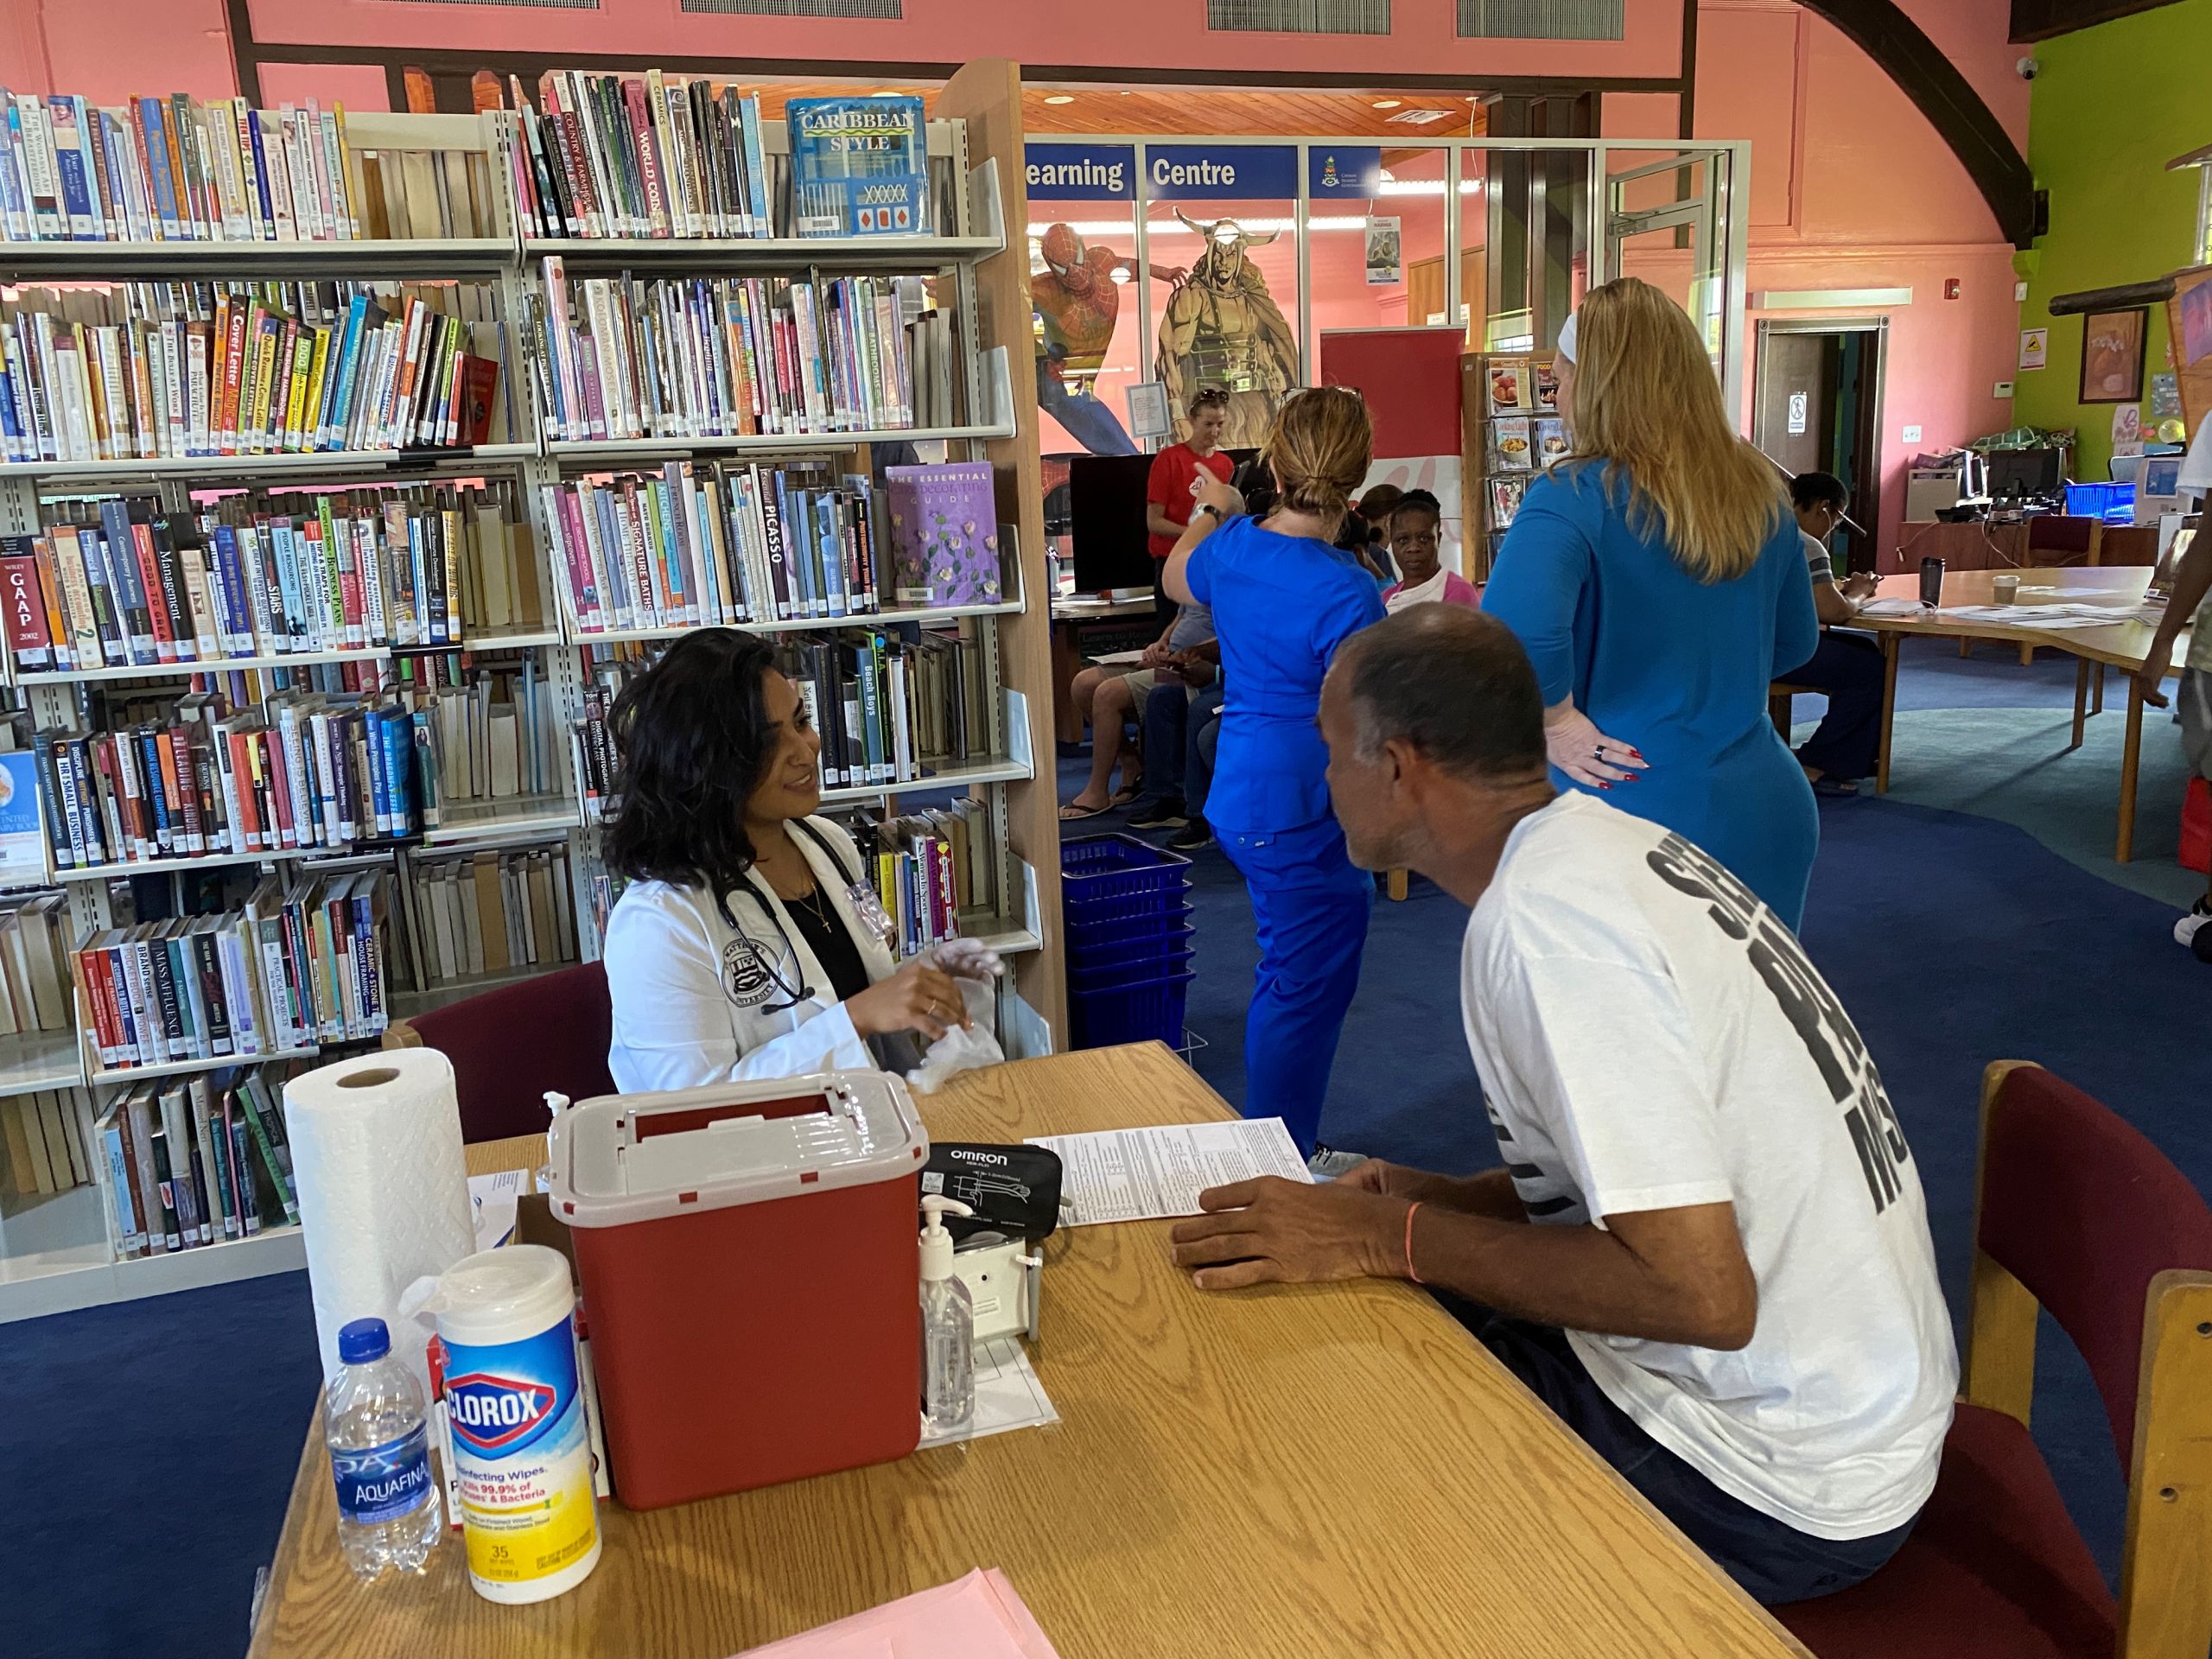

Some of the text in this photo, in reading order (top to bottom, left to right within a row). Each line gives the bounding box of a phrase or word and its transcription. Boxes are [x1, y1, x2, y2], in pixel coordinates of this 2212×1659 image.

[654, 86, 665, 125] CERAMICS
[238, 118, 251, 152] TEEN TIPS
[564, 113, 580, 154] COUNTRY
[802, 112, 915, 151] CARIBBEAN STYLE
[24, 127, 41, 193] BREASTFEEDING
[639, 131, 654, 178] WORLD
[1026, 157, 1236, 193] earning Centre
[43, 178, 52, 193] ART
[226, 314, 245, 417] Cover Letter Magic
[297, 340, 310, 367] 1000
[595, 297, 618, 394] KOLOMAN MOSER
[868, 332, 881, 388] BATHROOMS
[166, 337, 181, 414] THE BULLY AT WORK
[246, 360, 258, 416] COVER LETTERS
[255, 335, 273, 429] Quick Resume Cover Letter
[278, 334, 296, 417] THE RESUME HANDBOOK
[190, 372, 200, 423] PARACHUTE?
[920, 473, 988, 482] ESSENTIAL
[658, 486, 672, 532] KITCHENS
[671, 486, 685, 547] FRENCH ROOM
[911, 495, 970, 505] GUIDE
[308, 542, 317, 563] WRITING
[565, 532, 577, 566] slipcovers
[765, 505, 783, 564] PICASSO
[90, 571, 101, 585] Risk
[118, 536, 138, 604] Contemporary Business
[281, 531, 297, 591] PEOPLE RESOURCING
[319, 566, 327, 588] TRAPS
[327, 556, 340, 594] BUSINESS
[433, 557, 442, 590] Development
[631, 521, 654, 612] SIGNATURE BATHS
[10, 572, 32, 628] GAAP
[66, 555, 95, 640] business accounting 2
[141, 557, 167, 642] GOOD TO GREA
[159, 550, 181, 620] Management
[247, 537, 271, 631] 96 GREAT INTERVIEW QUESTIONS
[267, 586, 283, 614] STARS
[368, 549, 385, 622] building successful
[332, 597, 343, 623] PLANS
[19, 631, 40, 641] 2002
[864, 664, 877, 716] Beach Boys
[369, 731, 378, 750] When
[71, 747, 85, 780] DISCIPLINE
[118, 735, 137, 796] Return on Learning
[144, 739, 169, 830] HUMAN RESOURCE CHAMPIONS
[175, 749, 193, 791] LEADING
[371, 750, 381, 781] Principles
[48, 795, 63, 839] customization
[59, 762, 84, 852] HR SMALL BUSINESS
[919, 880, 927, 889] In
[919, 890, 929, 914] Sports
[124, 947, 141, 1005] POCKETBOOK
[137, 946, 154, 999] BRAND sense
[272, 957, 285, 993] PRACTICAL
[356, 940, 370, 996] HOUSE FRAMING
[364, 938, 379, 1006] CERAMIC STONE
[119, 997, 131, 1019] KOTLER
[155, 950, 181, 1039] MASS AFFLUENCE
[277, 995, 289, 1027] PROJECTS
[194, 1095, 206, 1125] Manuel
[950, 1149, 1007, 1166] OMRON
[447, 1388, 540, 1429] CLOROX
[355, 1460, 429, 1505] AQUAFINA
[456, 1462, 510, 1484] infecting
[481, 1484, 520, 1498] 99.9%
[520, 1482, 535, 1496] of
[502, 1489, 546, 1507] Bacteria
[491, 1545, 509, 1559] 35
